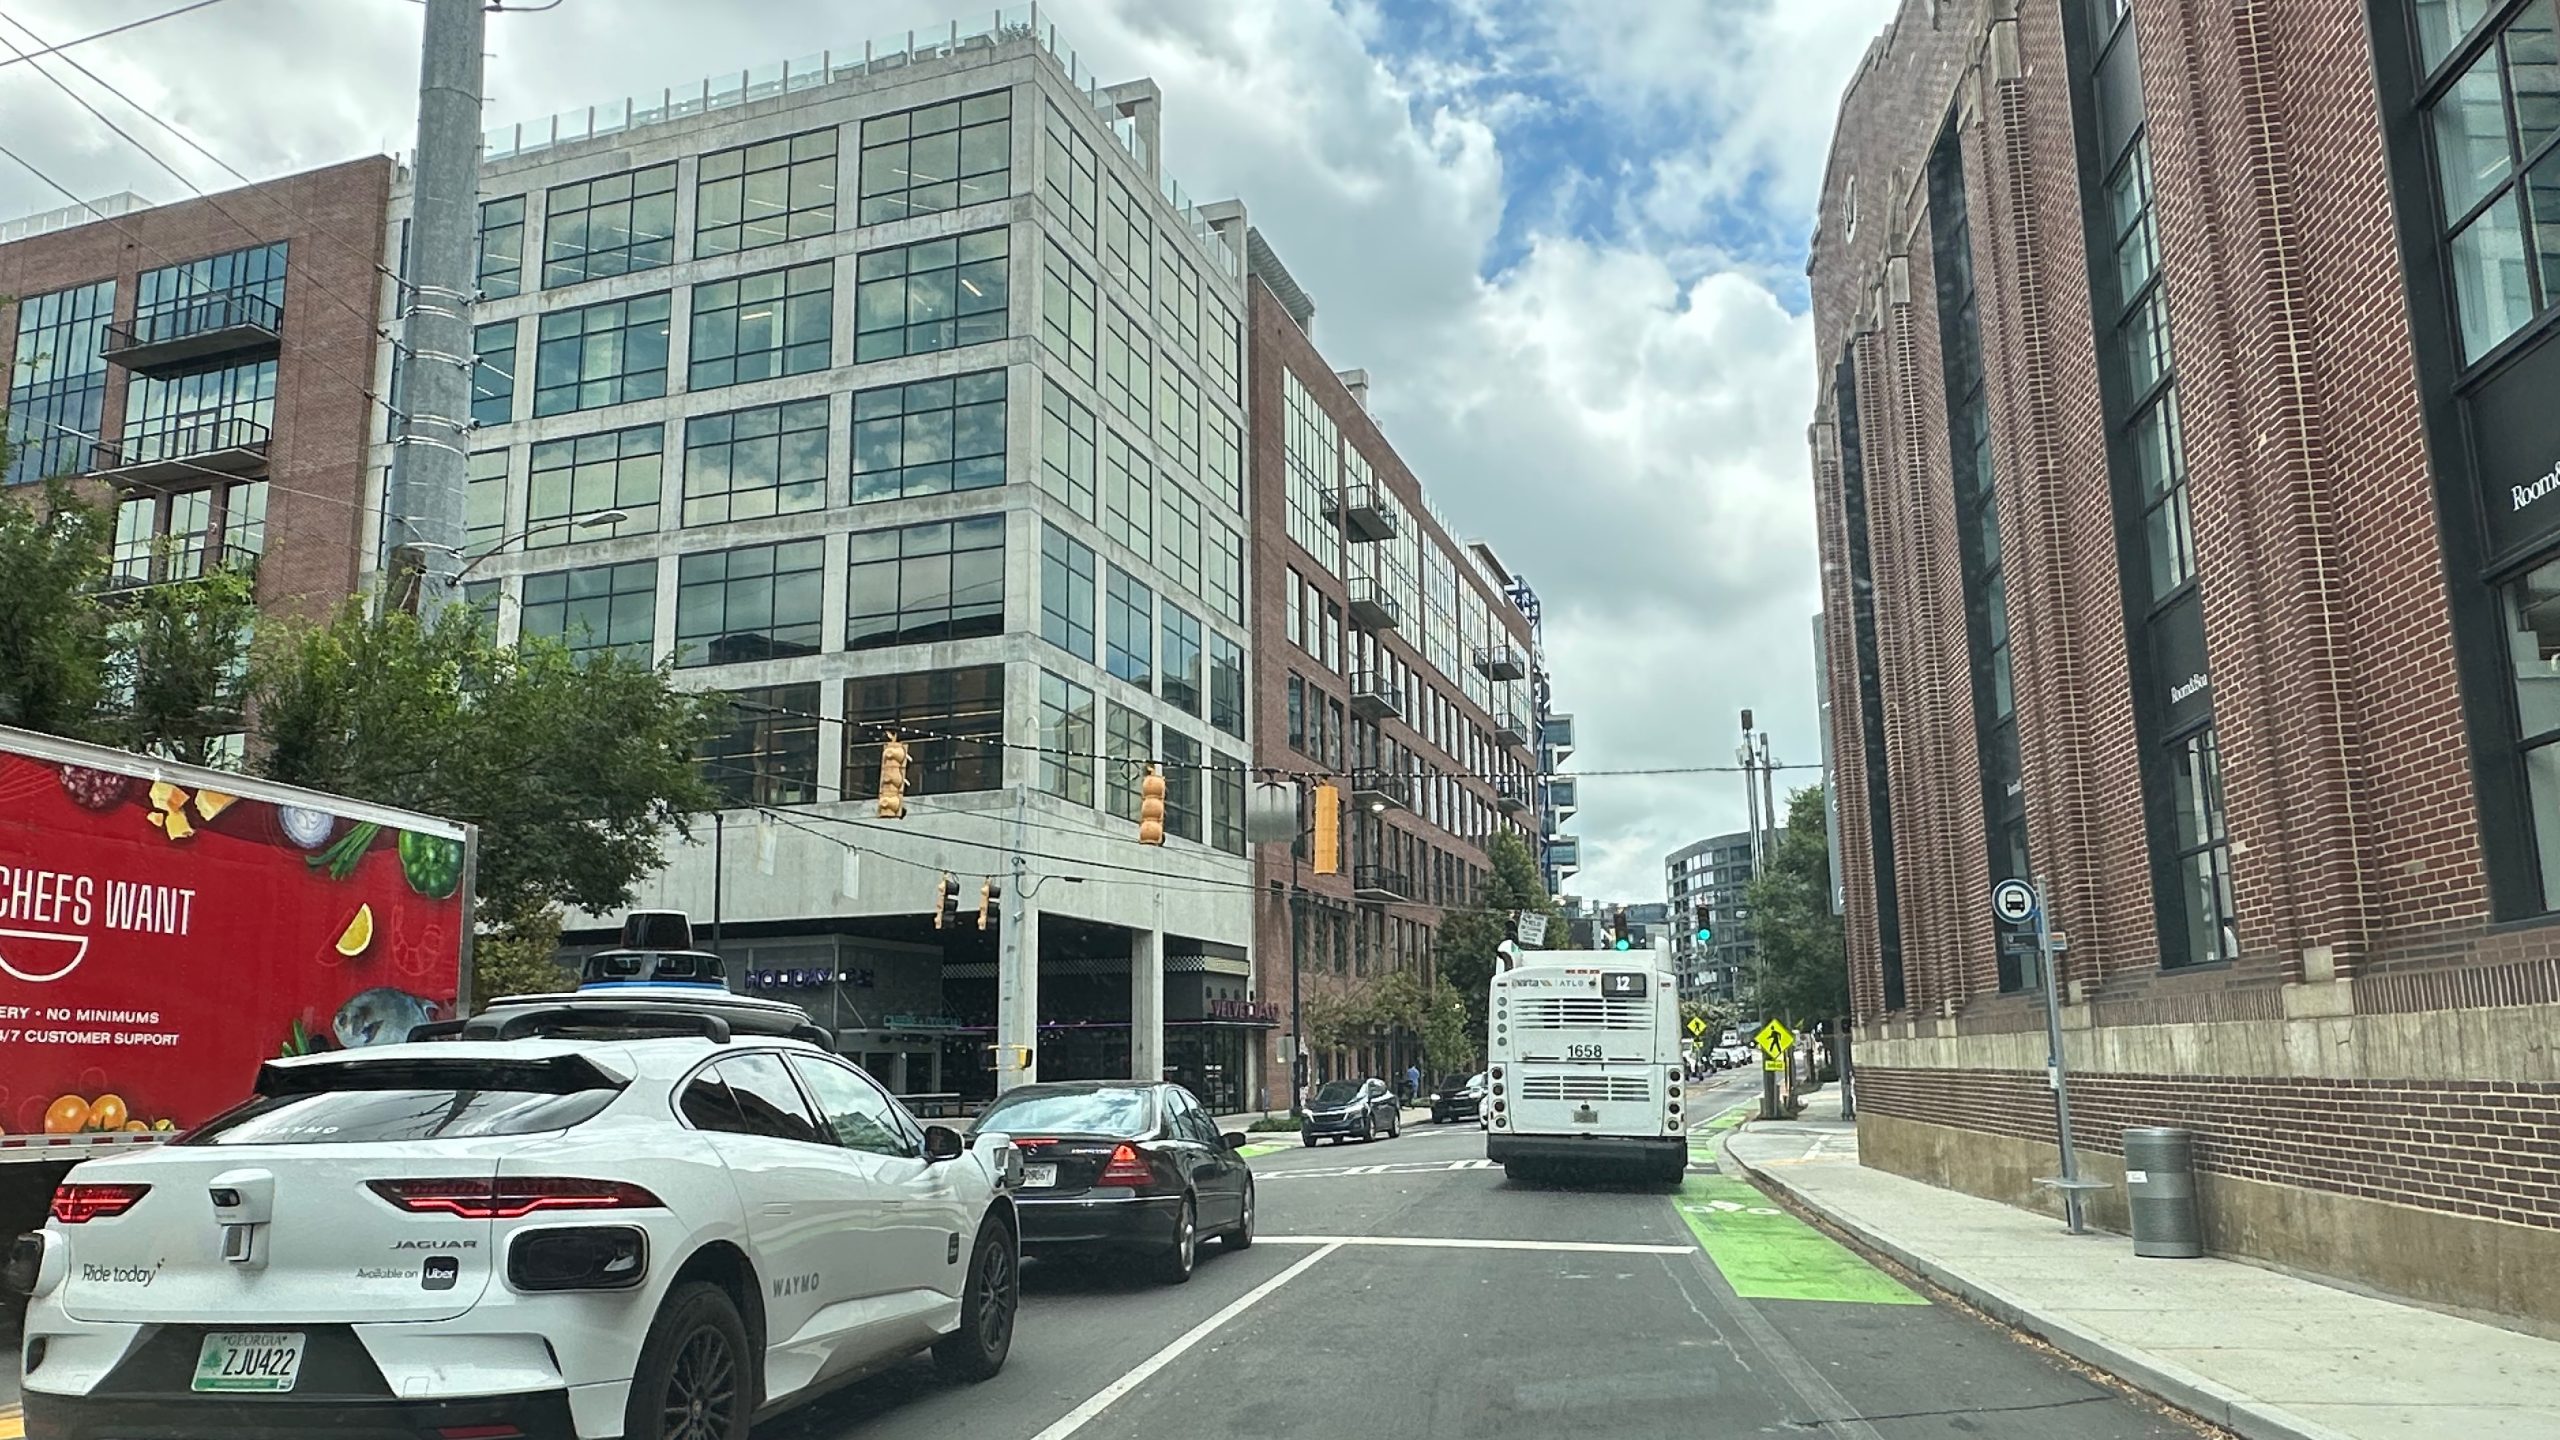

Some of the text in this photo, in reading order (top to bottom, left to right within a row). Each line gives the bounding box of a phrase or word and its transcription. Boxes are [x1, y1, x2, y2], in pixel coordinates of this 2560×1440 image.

[105, 879, 196, 936] WANT
[1615, 975, 1631, 991] 12
[46, 1008, 71, 1021] NO
[76, 1009, 160, 1024] MINIMUMS
[24, 1030, 111, 1045] CUSTOMER
[114, 1033, 179, 1046] SUPPORT
[1567, 1045, 1603, 1058] 1658
[389, 1240, 478, 1249] JAGUAR
[82, 1264, 156, 1287] Ride today
[356, 1267, 418, 1279] Available on
[425, 1267, 455, 1279] Uber
[772, 1272, 820, 1298] WAYMO
[227, 1334, 283, 1347] GEORGIA
[221, 1348, 297, 1376] ZJU422
